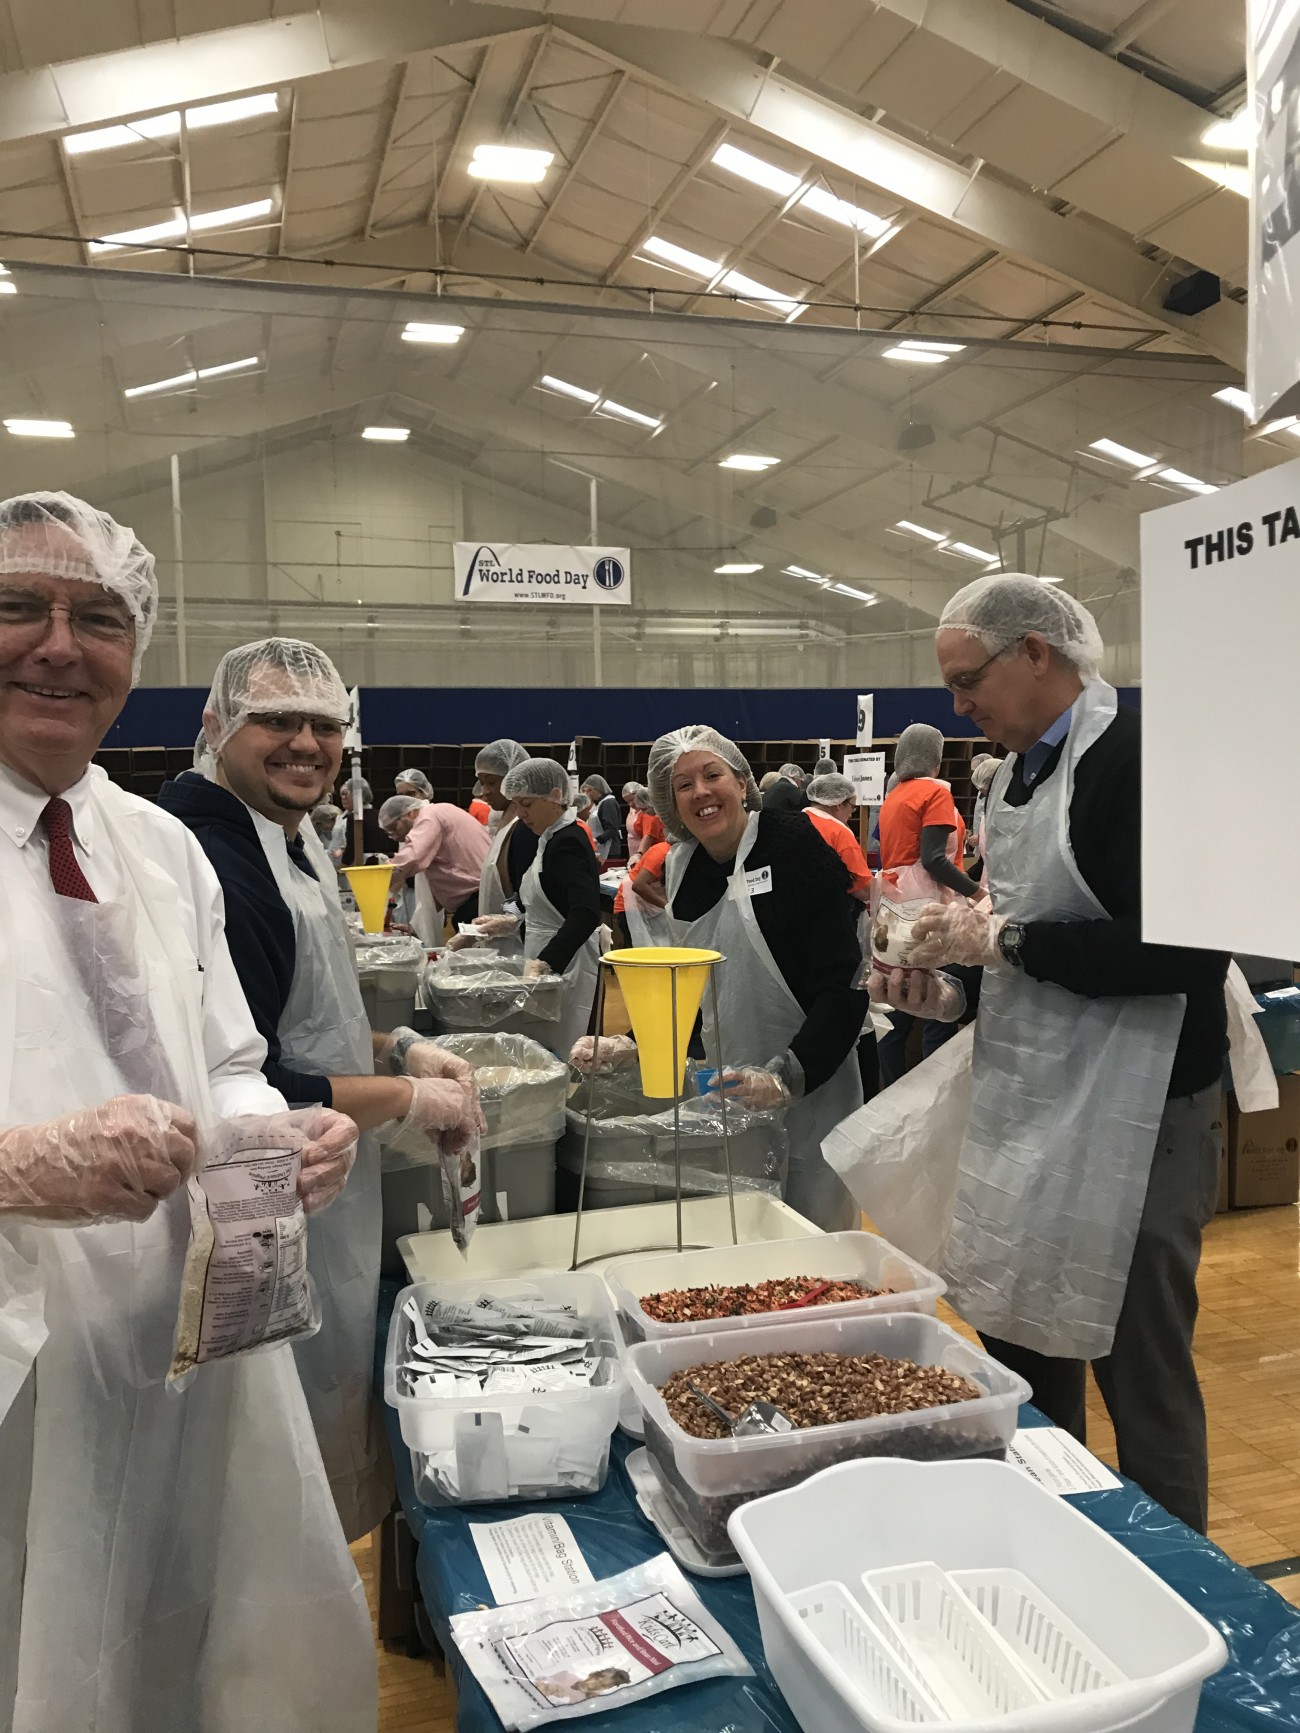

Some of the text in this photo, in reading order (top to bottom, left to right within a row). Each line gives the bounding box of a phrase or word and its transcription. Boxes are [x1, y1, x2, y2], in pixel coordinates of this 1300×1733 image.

[1184, 506, 1300, 569] THIS TA
[478, 568, 589, 589] World Food Day
[514, 592, 566, 600] www.STLWFD.org
[857, 709, 866, 732] 9
[820, 746, 826, 759] 5
[542, 1515, 580, 1584] Vitamin/Bag Station
